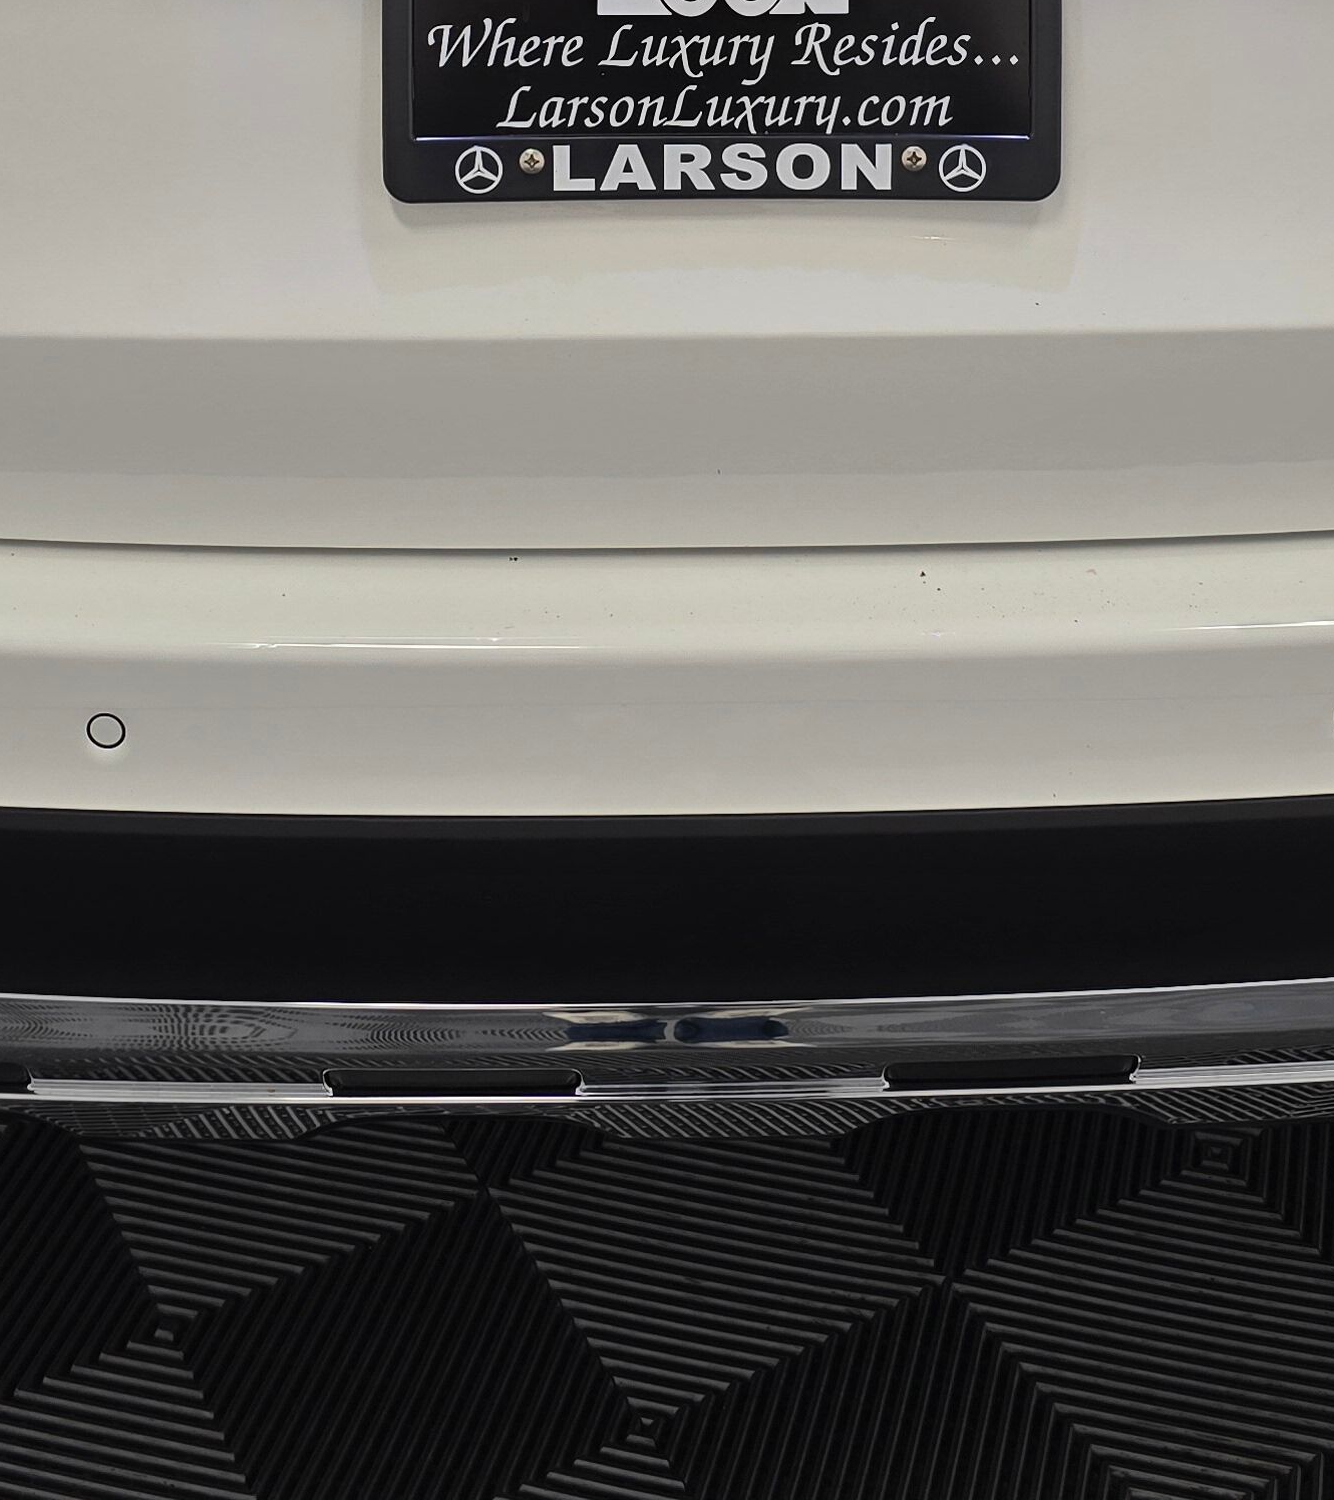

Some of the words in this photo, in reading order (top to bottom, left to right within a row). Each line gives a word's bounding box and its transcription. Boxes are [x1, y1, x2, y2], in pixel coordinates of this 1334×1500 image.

[427, 17, 584, 68] Where
[598, 23, 775, 85] Luxury
[793, 17, 1020, 75] Resides...
[496, 84, 954, 136] LarsonLuxury.com
[552, 143, 893, 192] LARSON
